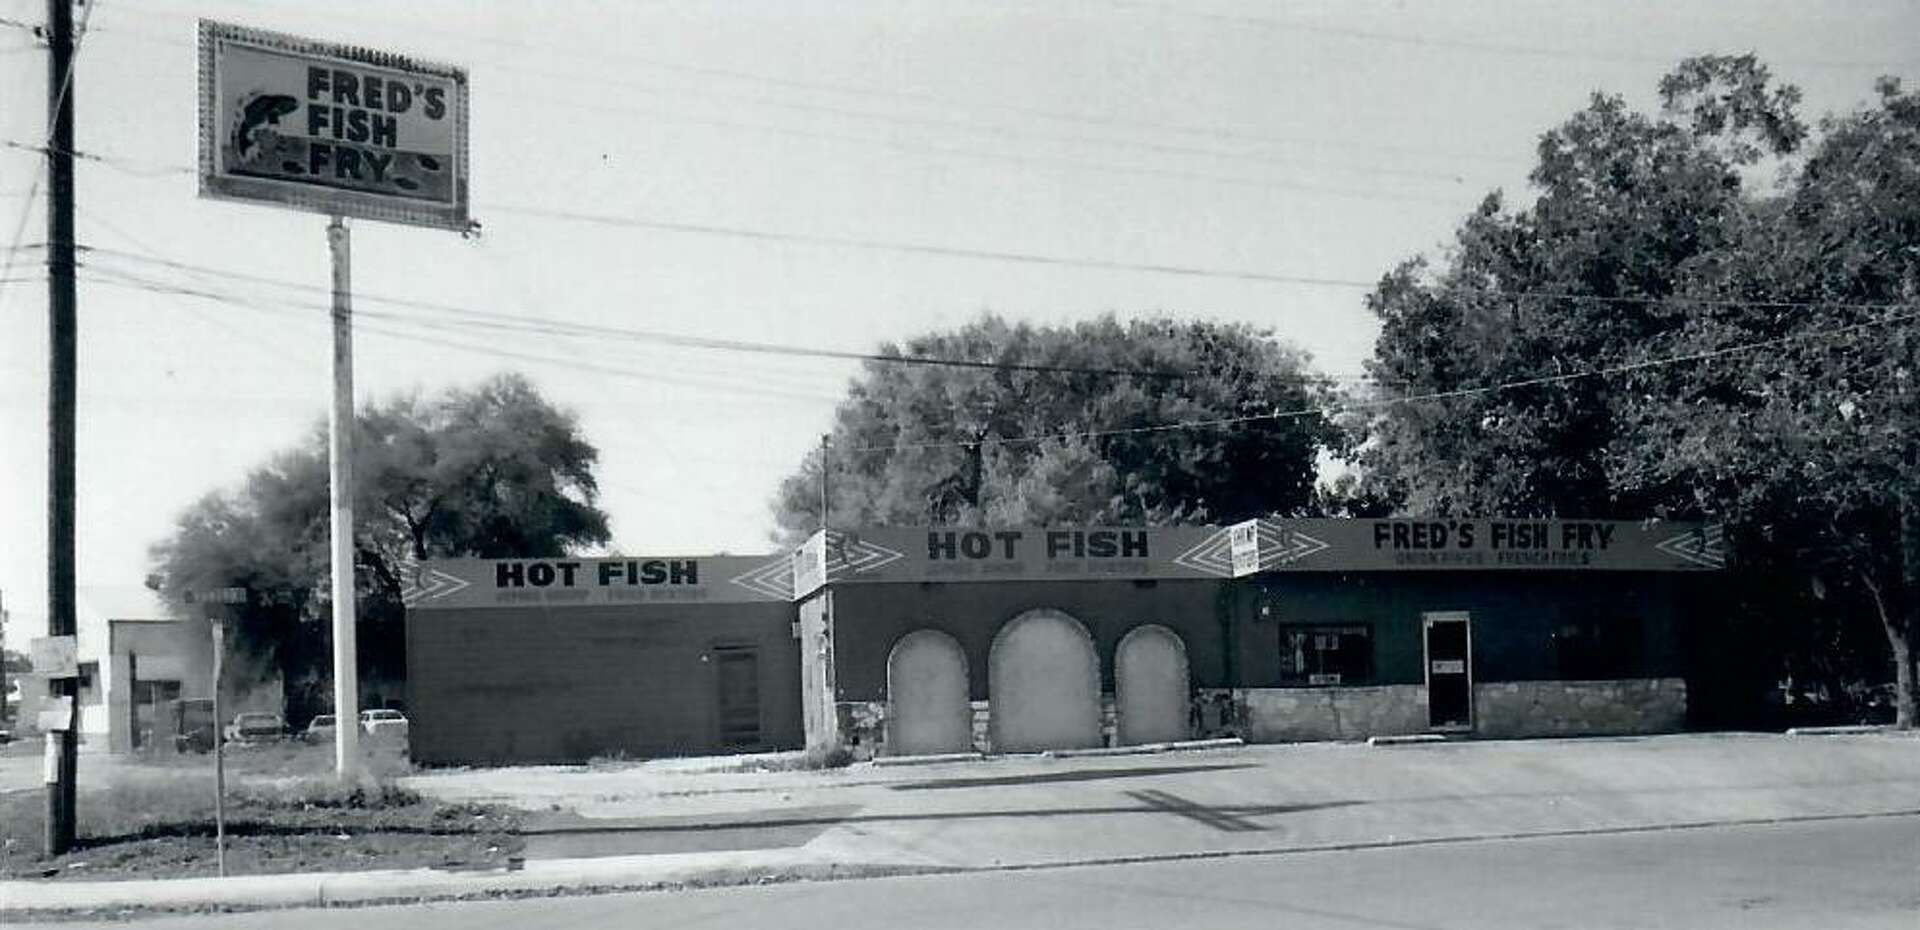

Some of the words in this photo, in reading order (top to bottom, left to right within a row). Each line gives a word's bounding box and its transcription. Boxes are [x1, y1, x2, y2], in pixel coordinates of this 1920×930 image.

[307, 66, 446, 120] FRED'S
[308, 104, 397, 147] FISH
[309, 143, 393, 182] FRY
[927, 532, 1021, 559] HOT
[1046, 532, 1149, 558] FISH
[1373, 522, 1475, 549] FRED'S
[1491, 522, 1550, 549] FISH
[1561, 522, 1615, 549] FRY
[496, 560, 581, 588] HOT
[599, 560, 698, 585] FISH
